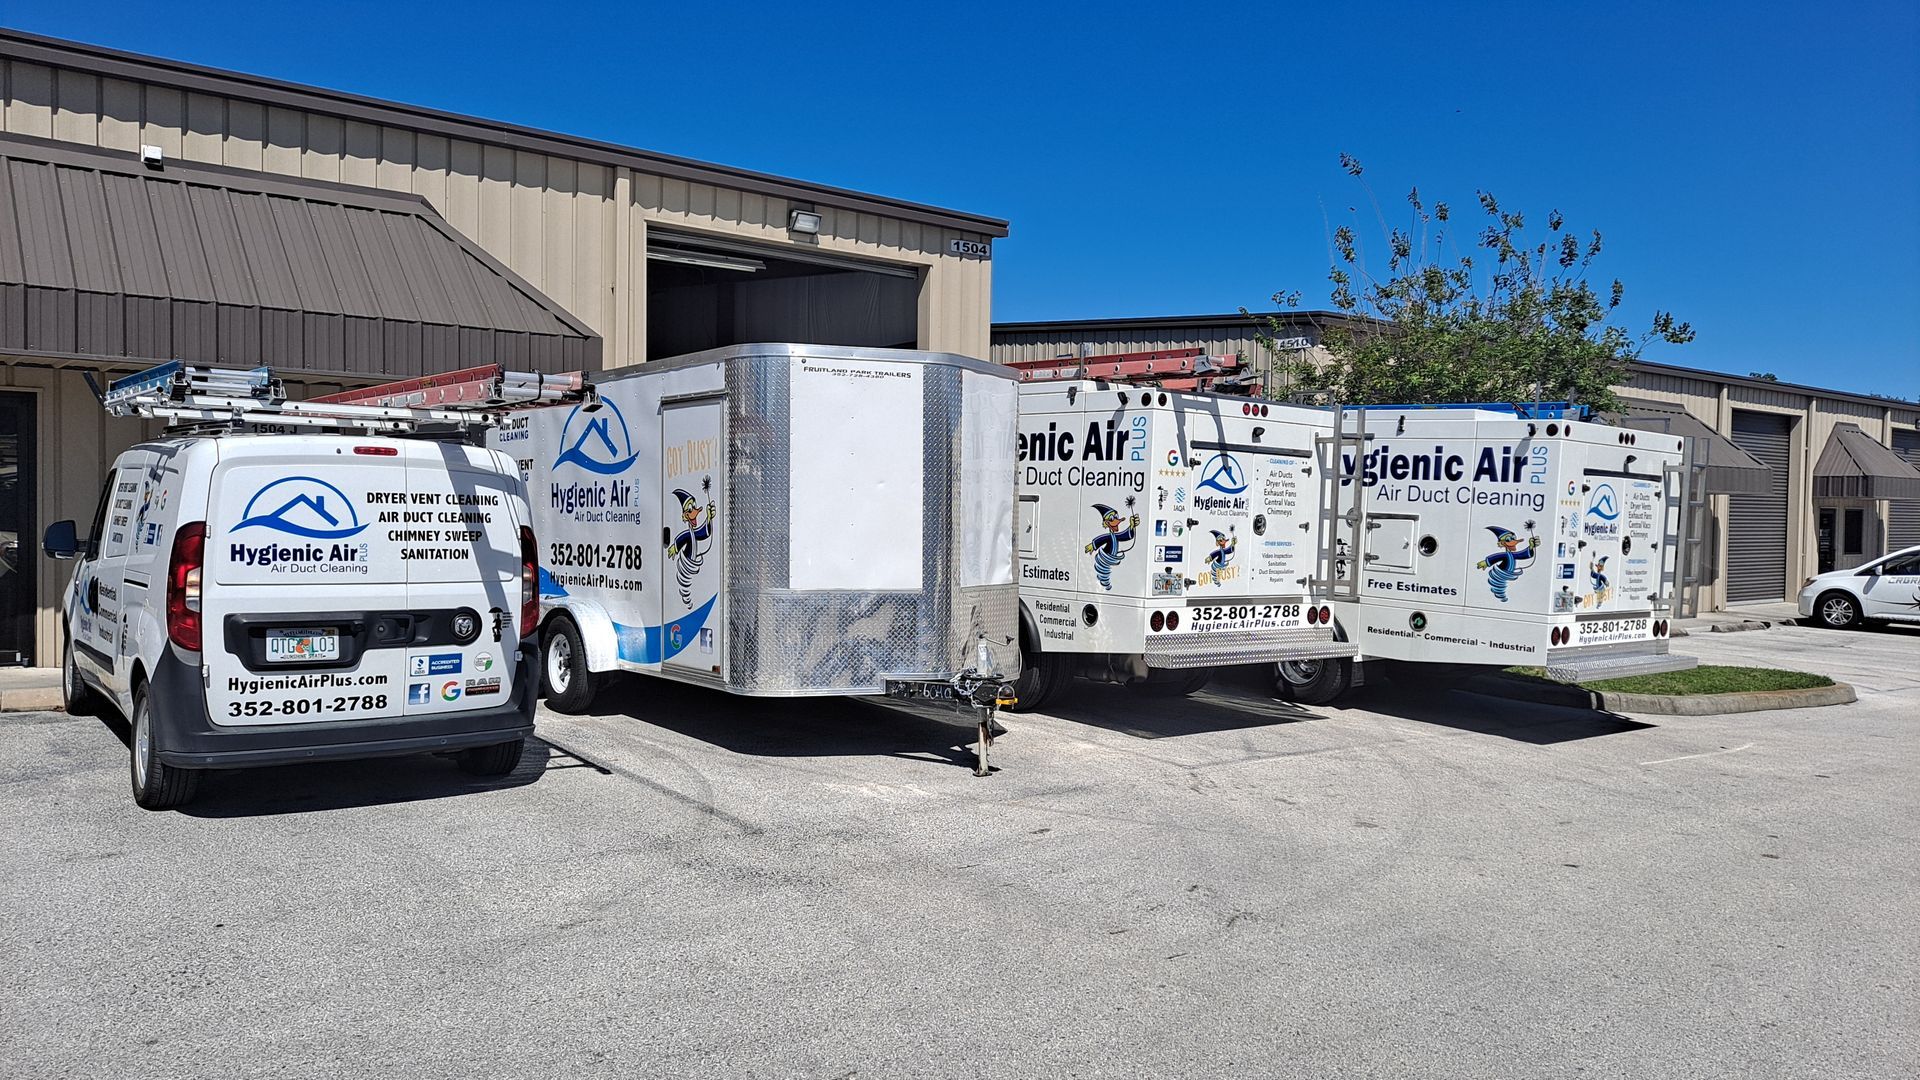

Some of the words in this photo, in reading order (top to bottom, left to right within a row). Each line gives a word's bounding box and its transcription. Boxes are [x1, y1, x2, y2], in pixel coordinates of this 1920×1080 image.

[953, 241, 988, 254] 1504
[803, 366, 848, 374] FRUITLAND
[874, 370, 912, 379] TRAILERS
[251, 423, 286, 433] 1504
[289, 425, 298, 434] J
[511, 416, 529, 430] DUCT
[499, 430, 529, 442] CLEANING
[1019, 422, 1075, 461] enic
[1082, 420, 1130, 461] Air
[1131, 416, 1147, 461] PLUS
[666, 446, 684, 480] GOT
[1341, 445, 1464, 487] ygienic
[1473, 446, 1529, 483] Air
[1530, 446, 1548, 485] PLUS
[1026, 467, 1062, 486] Duct
[1068, 466, 1145, 492] Cleaning
[1269, 470, 1277, 478] Air
[1278, 470, 1293, 478] Ducts
[1266, 479, 1281, 488] Dryer
[1281, 480, 1295, 488] Vents
[366, 492, 407, 504] DRYER
[410, 493, 441, 505] VENT
[445, 494, 499, 506] CLEANING
[551, 481, 606, 514] Hygienic
[610, 479, 631, 508] Air
[1263, 488, 1284, 497] Exhaust
[1285, 489, 1297, 498] Fans
[1376, 484, 1402, 501] Air
[1408, 485, 1450, 504] Duct
[1456, 486, 1545, 512] Cleaning
[1194, 496, 1231, 510] Hygienic
[1233, 497, 1245, 509] Air
[1264, 497, 1283, 506] Central
[1283, 498, 1295, 507] Vacs
[378, 511, 399, 523] AIR
[403, 512, 433, 523] DUCT
[438, 512, 492, 524] CLEANING
[574, 511, 585, 522] Air
[586, 511, 604, 522] Duct
[605, 510, 641, 525] Cleaning
[1229, 510, 1249, 518] Cleaning
[1266, 507, 1292, 517] Chimneys
[388, 530, 441, 542] CHIMNEY
[444, 530, 483, 542] SWEEP
[1584, 522, 1608, 536] Hygienic
[230, 543, 324, 566] Hygienic
[329, 543, 358, 562] Air
[359, 543, 368, 562] PLUS
[400, 548, 469, 560] SANITATION
[550, 542, 642, 570] 352-801-2788
[270, 563, 287, 573] Air
[290, 563, 317, 573] Duct
[321, 563, 368, 574] Cleaning
[1023, 564, 1070, 581] Estimates
[550, 571, 643, 591] HygienicAirPlus.com
[1198, 571, 1213, 586] GOT
[1367, 578, 1393, 590] Free
[1396, 581, 1457, 596] Estimates
[1035, 600, 1070, 613] Residential
[1192, 605, 1300, 620] 352-801-2788
[1040, 614, 1077, 627] Commercial
[1191, 619, 1300, 632] HygienicAirPlus.com
[1579, 619, 1647, 634] 352-801-2788
[1044, 628, 1074, 640] Industrial
[1367, 626, 1414, 638] Residential
[1424, 632, 1478, 646] Commercial
[1489, 640, 1535, 653] Industrial
[1579, 633, 1647, 644] HygienicAirPlus.com
[228, 674, 388, 695] HygienicAirPlus.com
[228, 694, 388, 717] 352-801-2788
